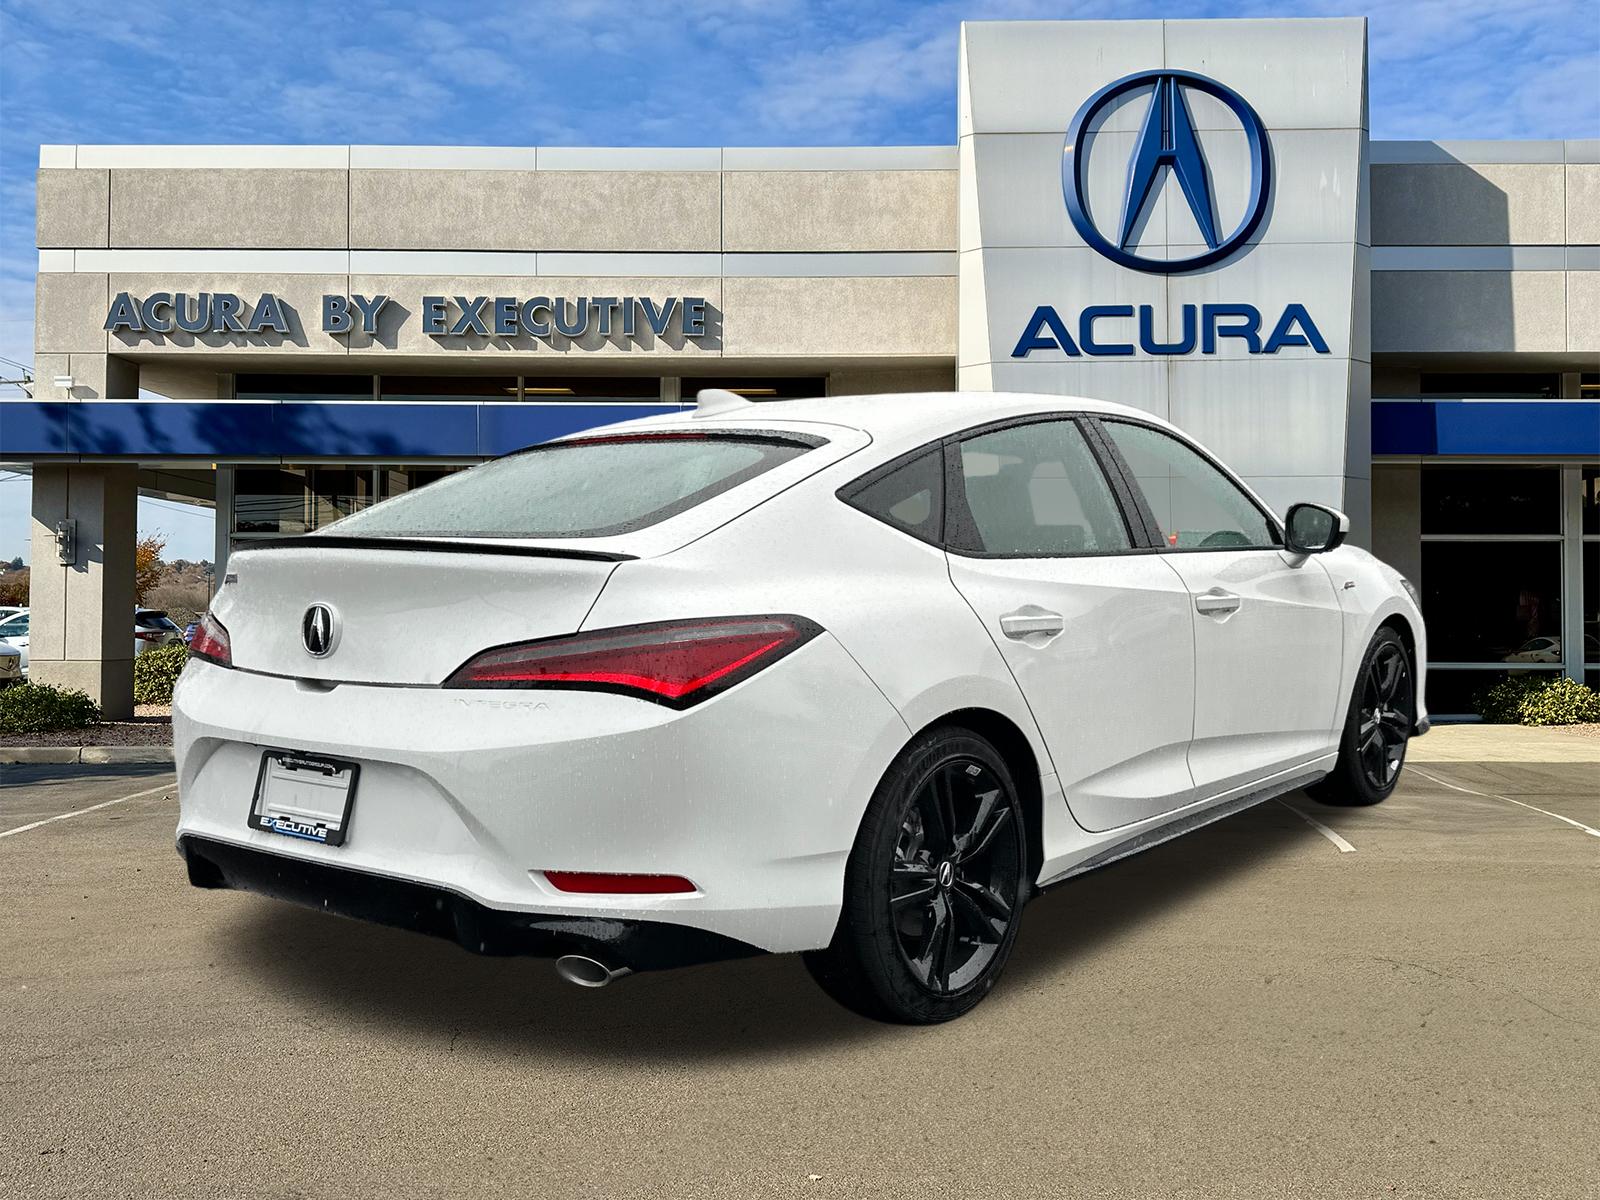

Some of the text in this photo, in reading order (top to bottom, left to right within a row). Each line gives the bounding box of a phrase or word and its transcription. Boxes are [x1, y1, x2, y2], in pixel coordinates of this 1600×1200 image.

[104, 291, 706, 337] ACURA BY EXECUTIVE
[1011, 303, 1332, 357] ACURA
[260, 816, 328, 838] EXECUTIVE
